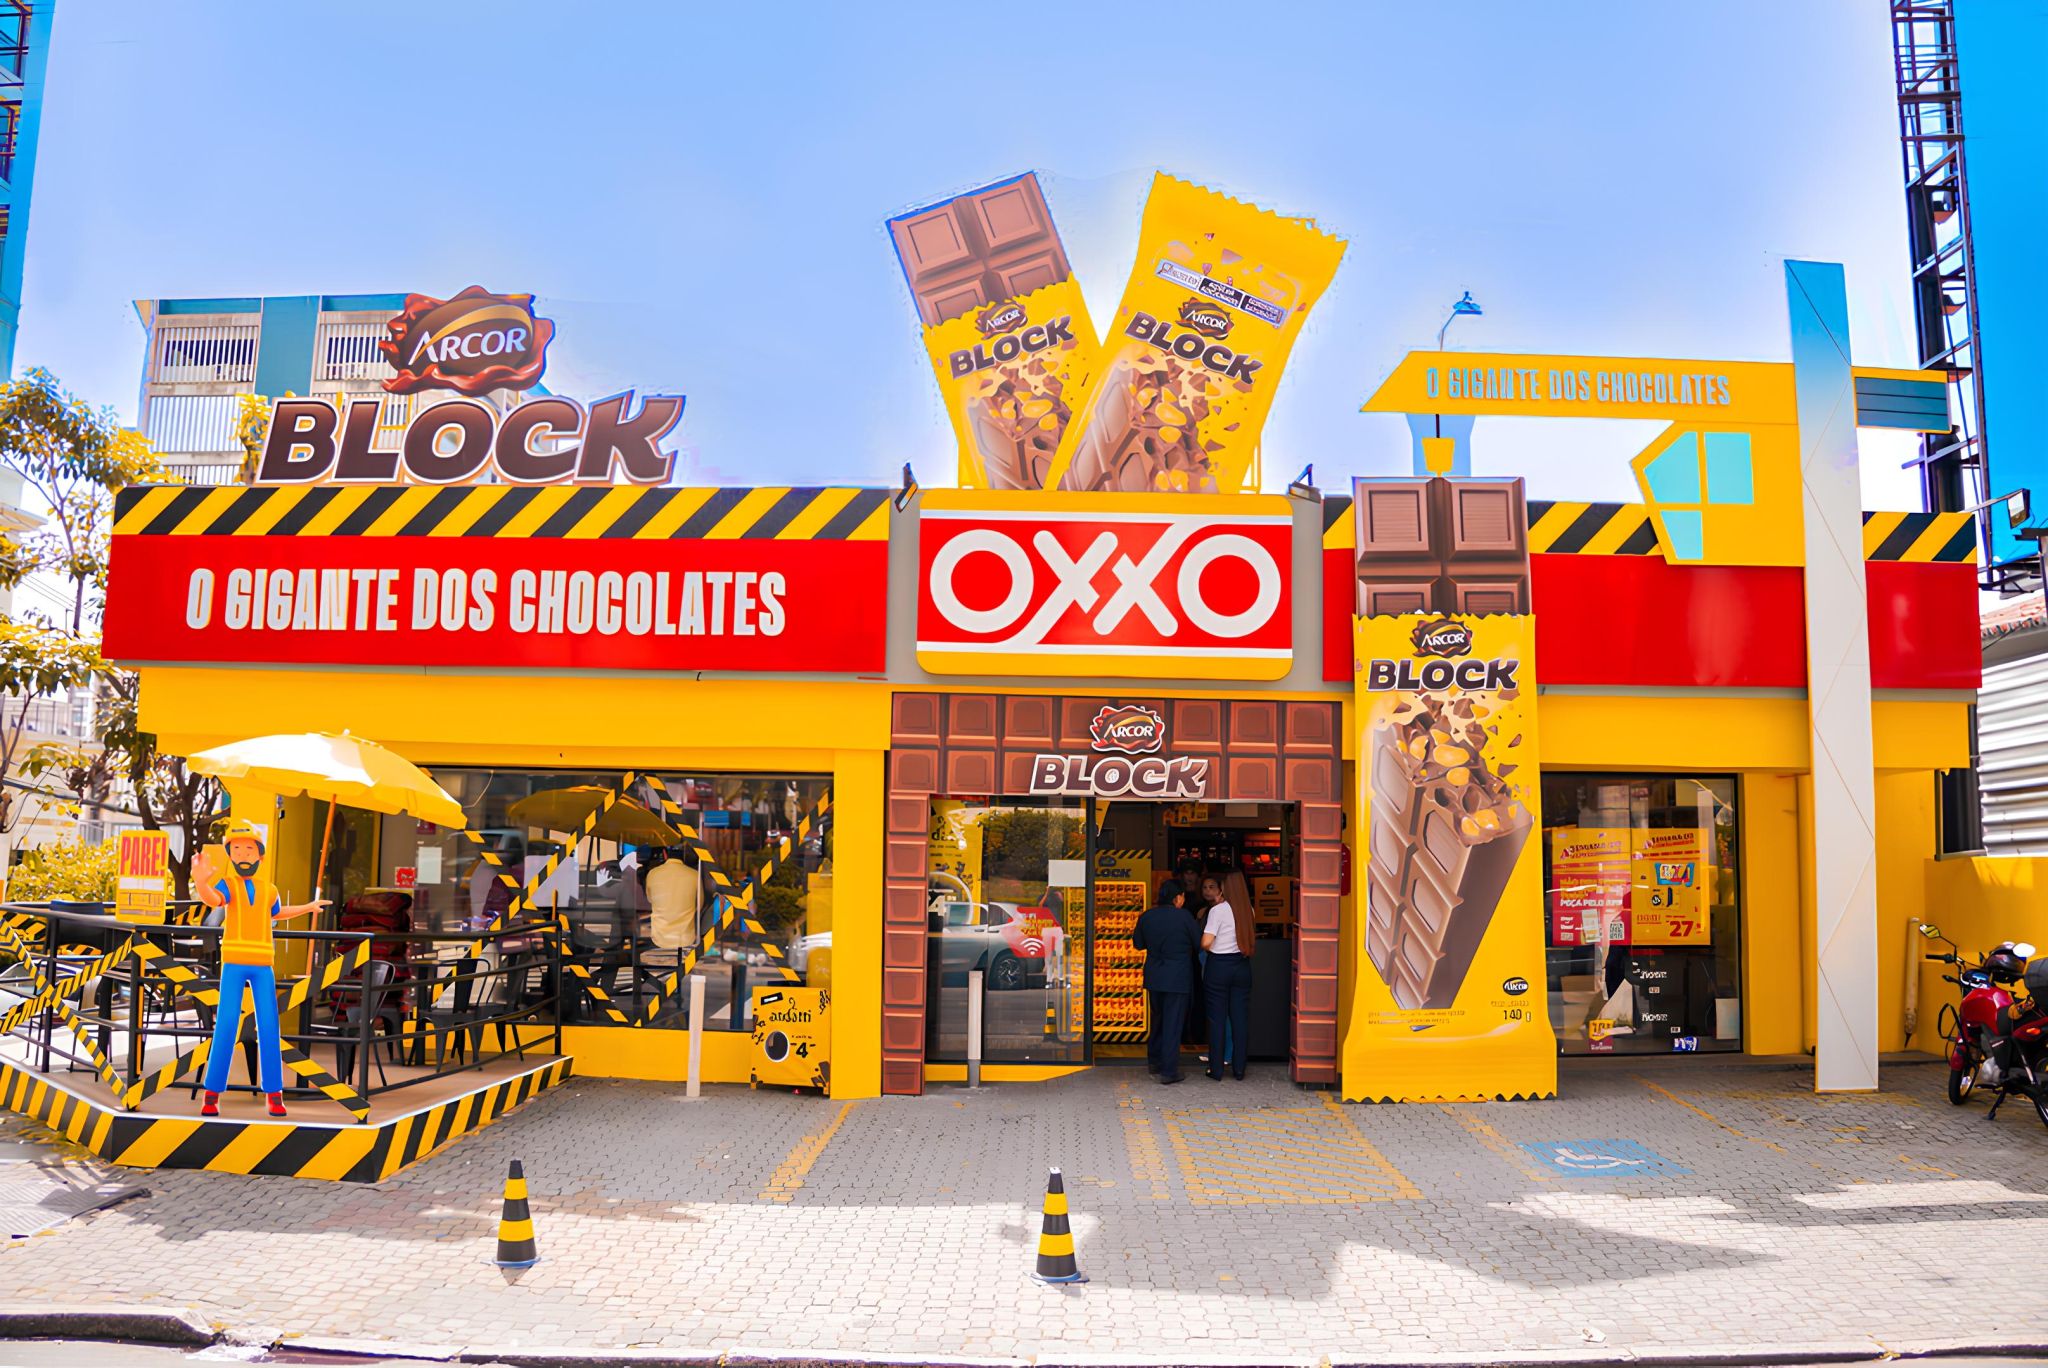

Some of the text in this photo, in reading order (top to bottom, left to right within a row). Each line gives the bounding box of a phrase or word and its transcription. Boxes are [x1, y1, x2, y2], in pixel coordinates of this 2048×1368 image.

[986, 309, 1021, 331] ARCOR
[408, 327, 527, 366] ARCOR
[949, 315, 1074, 380] BLOCK
[1125, 311, 1263, 385] BLOCK
[1426, 367, 1730, 406] O GIGANTE DOS CHOCOLATES
[255, 390, 687, 486] BLOCK
[186, 567, 787, 637] O GIGANTE DOS CHOCOLATES
[929, 524, 1282, 645] OXXO
[1421, 633, 1465, 647] ARCOR
[1367, 658, 1520, 692] BLOCK
[1103, 723, 1154, 738] ARCOR
[1030, 754, 1208, 798] BLOCK
[120, 836, 167, 877] PARE!
[1669, 920, 1694, 938] 27
